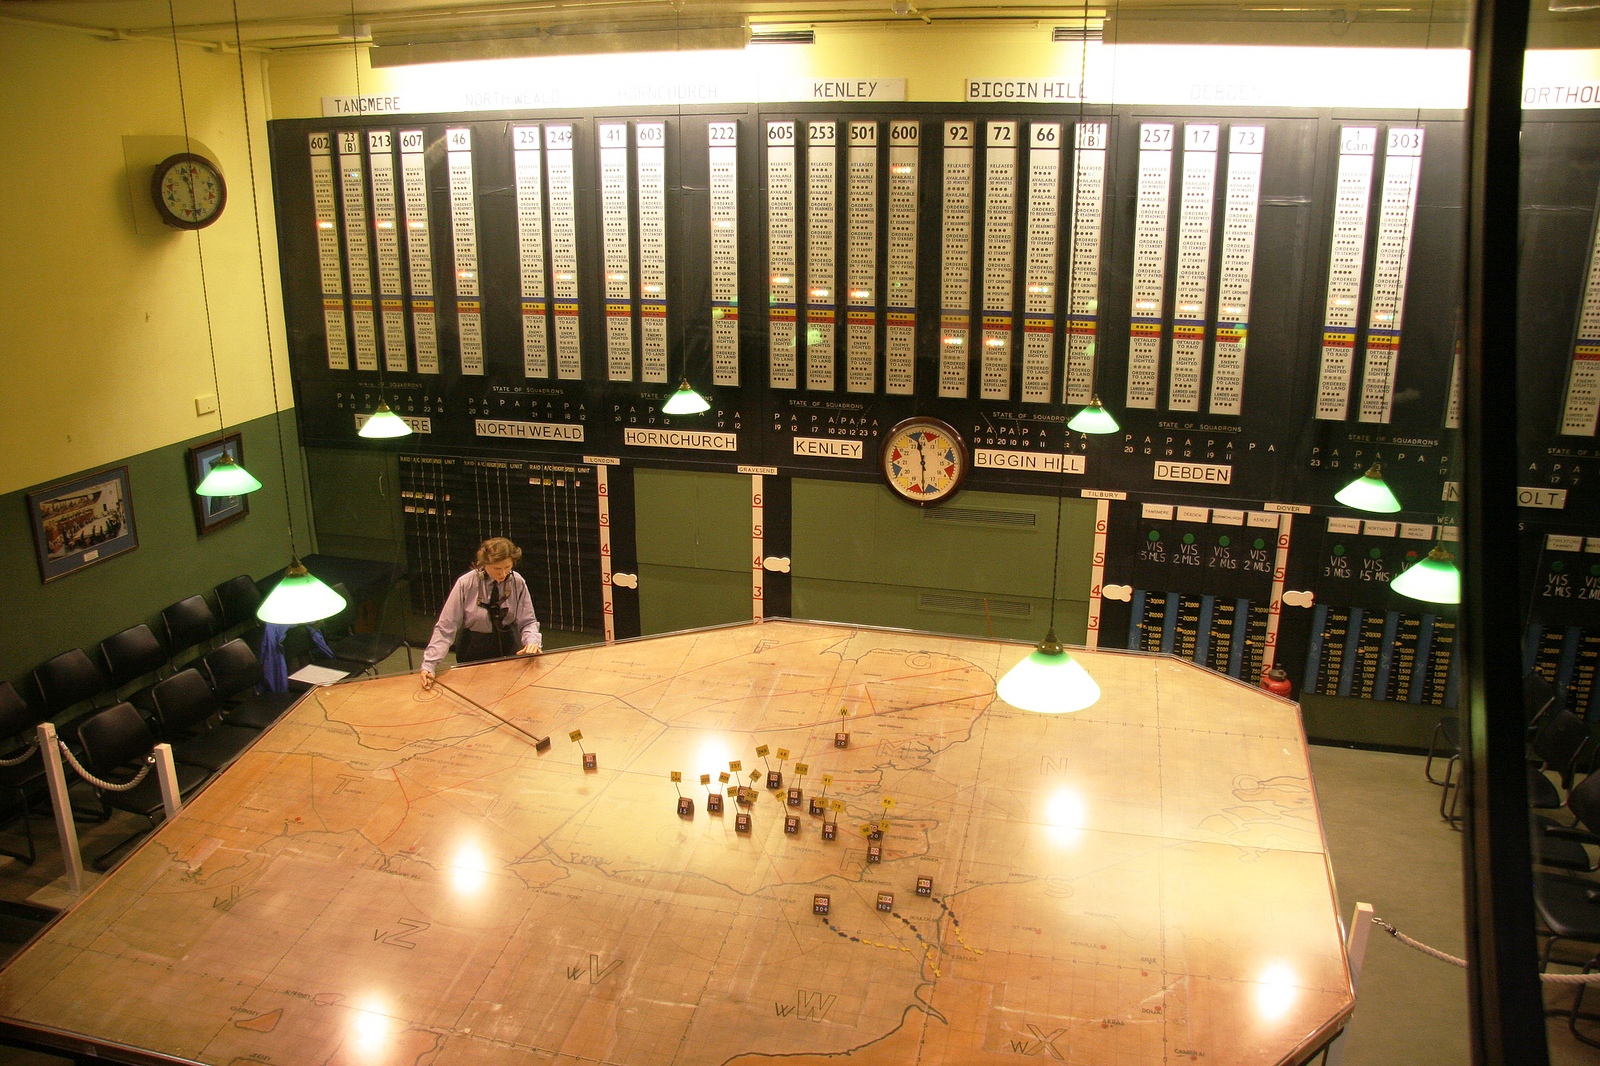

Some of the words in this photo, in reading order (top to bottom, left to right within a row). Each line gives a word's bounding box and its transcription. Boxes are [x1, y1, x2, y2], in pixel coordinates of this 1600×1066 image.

[814, 81, 878, 98] KENLEY
[970, 82, 1038, 98] BIGGIN
[1043, 82, 1088, 99] HILL
[335, 96, 401, 114] TANGMERE
[640, 128, 662, 141] 603
[711, 127, 735, 140] 222
[768, 126, 793, 139] 605
[809, 126, 834, 139] 253
[851, 126, 875, 139] 501
[891, 126, 917, 139] 600
[949, 126, 968, 140] 92
[993, 126, 1011, 140] 72
[1036, 127, 1055, 141] 66
[1081, 123, 1101, 135] 141
[344, 132, 355, 142] 23
[371, 135, 391, 148] 213
[402, 134, 422, 148] 607
[451, 133, 466, 146] 46
[520, 131, 534, 144] 25
[550, 130, 572, 144] 249
[607, 129, 620, 142] 41
[1082, 136, 1100, 147] (B)
[1144, 129, 1170, 143] 257
[1193, 130, 1210, 144] 17
[1238, 131, 1255, 145] 73
[1389, 133, 1419, 148] 303
[310, 137, 330, 150] 602
[344, 143, 356, 153] (B)
[1340, 140, 1373, 152] (Can)
[826, 402, 863, 410] SQUADRONS
[478, 423, 528, 437] NORTH
[529, 426, 582, 440] WEALD
[1199, 424, 1242, 432] SQUADRONS
[627, 432, 735, 449] HORNCHURCH
[1392, 437, 1439, 446] SQUADRONS
[796, 440, 861, 457] KENLEY
[977, 452, 1036, 469] BIGGIN
[1044, 457, 1079, 472] HILL
[1157, 464, 1228, 482] DEBDEN
[599, 484, 607, 494] 6
[753, 493, 762, 505] 6
[600, 513, 609, 525] 5
[753, 525, 762, 536] 5
[1096, 520, 1106, 531] 6
[1279, 534, 1288, 545] 6
[601, 544, 609, 554] 4
[1146, 541, 1163, 553] VIS
[1180, 544, 1198, 555] VIS
[1213, 546, 1230, 558] VIS
[1094, 552, 1104, 564] 5
[1148, 552, 1166, 563] MLS
[1173, 554, 1181, 565] 2
[1181, 554, 1200, 566] MLS
[1249, 549, 1267, 561] VIS
[753, 556, 762, 567] 4
[1209, 557, 1216, 568] 2
[1220, 558, 1237, 570] MLS
[1244, 560, 1251, 571] 2
[1253, 561, 1271, 573] MLS
[1330, 556, 1347, 568] VIS
[1363, 558, 1383, 571] VIS
[603, 572, 611, 583] 3
[1275, 567, 1285, 579] 5
[1323, 567, 1330, 576] 3
[1333, 569, 1351, 579] MLS
[1375, 572, 1390, 583] MLS
[1548, 573, 1569, 586] VIS
[754, 586, 762, 598] 3
[1091, 585, 1101, 596] 4
[1542, 585, 1552, 598] 2
[1554, 586, 1572, 599] MLS
[604, 602, 612, 612] 2
[1270, 600, 1280, 611] 4
[1089, 616, 1098, 627] 3
[607, 630, 612, 640] 1
[1266, 632, 1276, 644] 3
